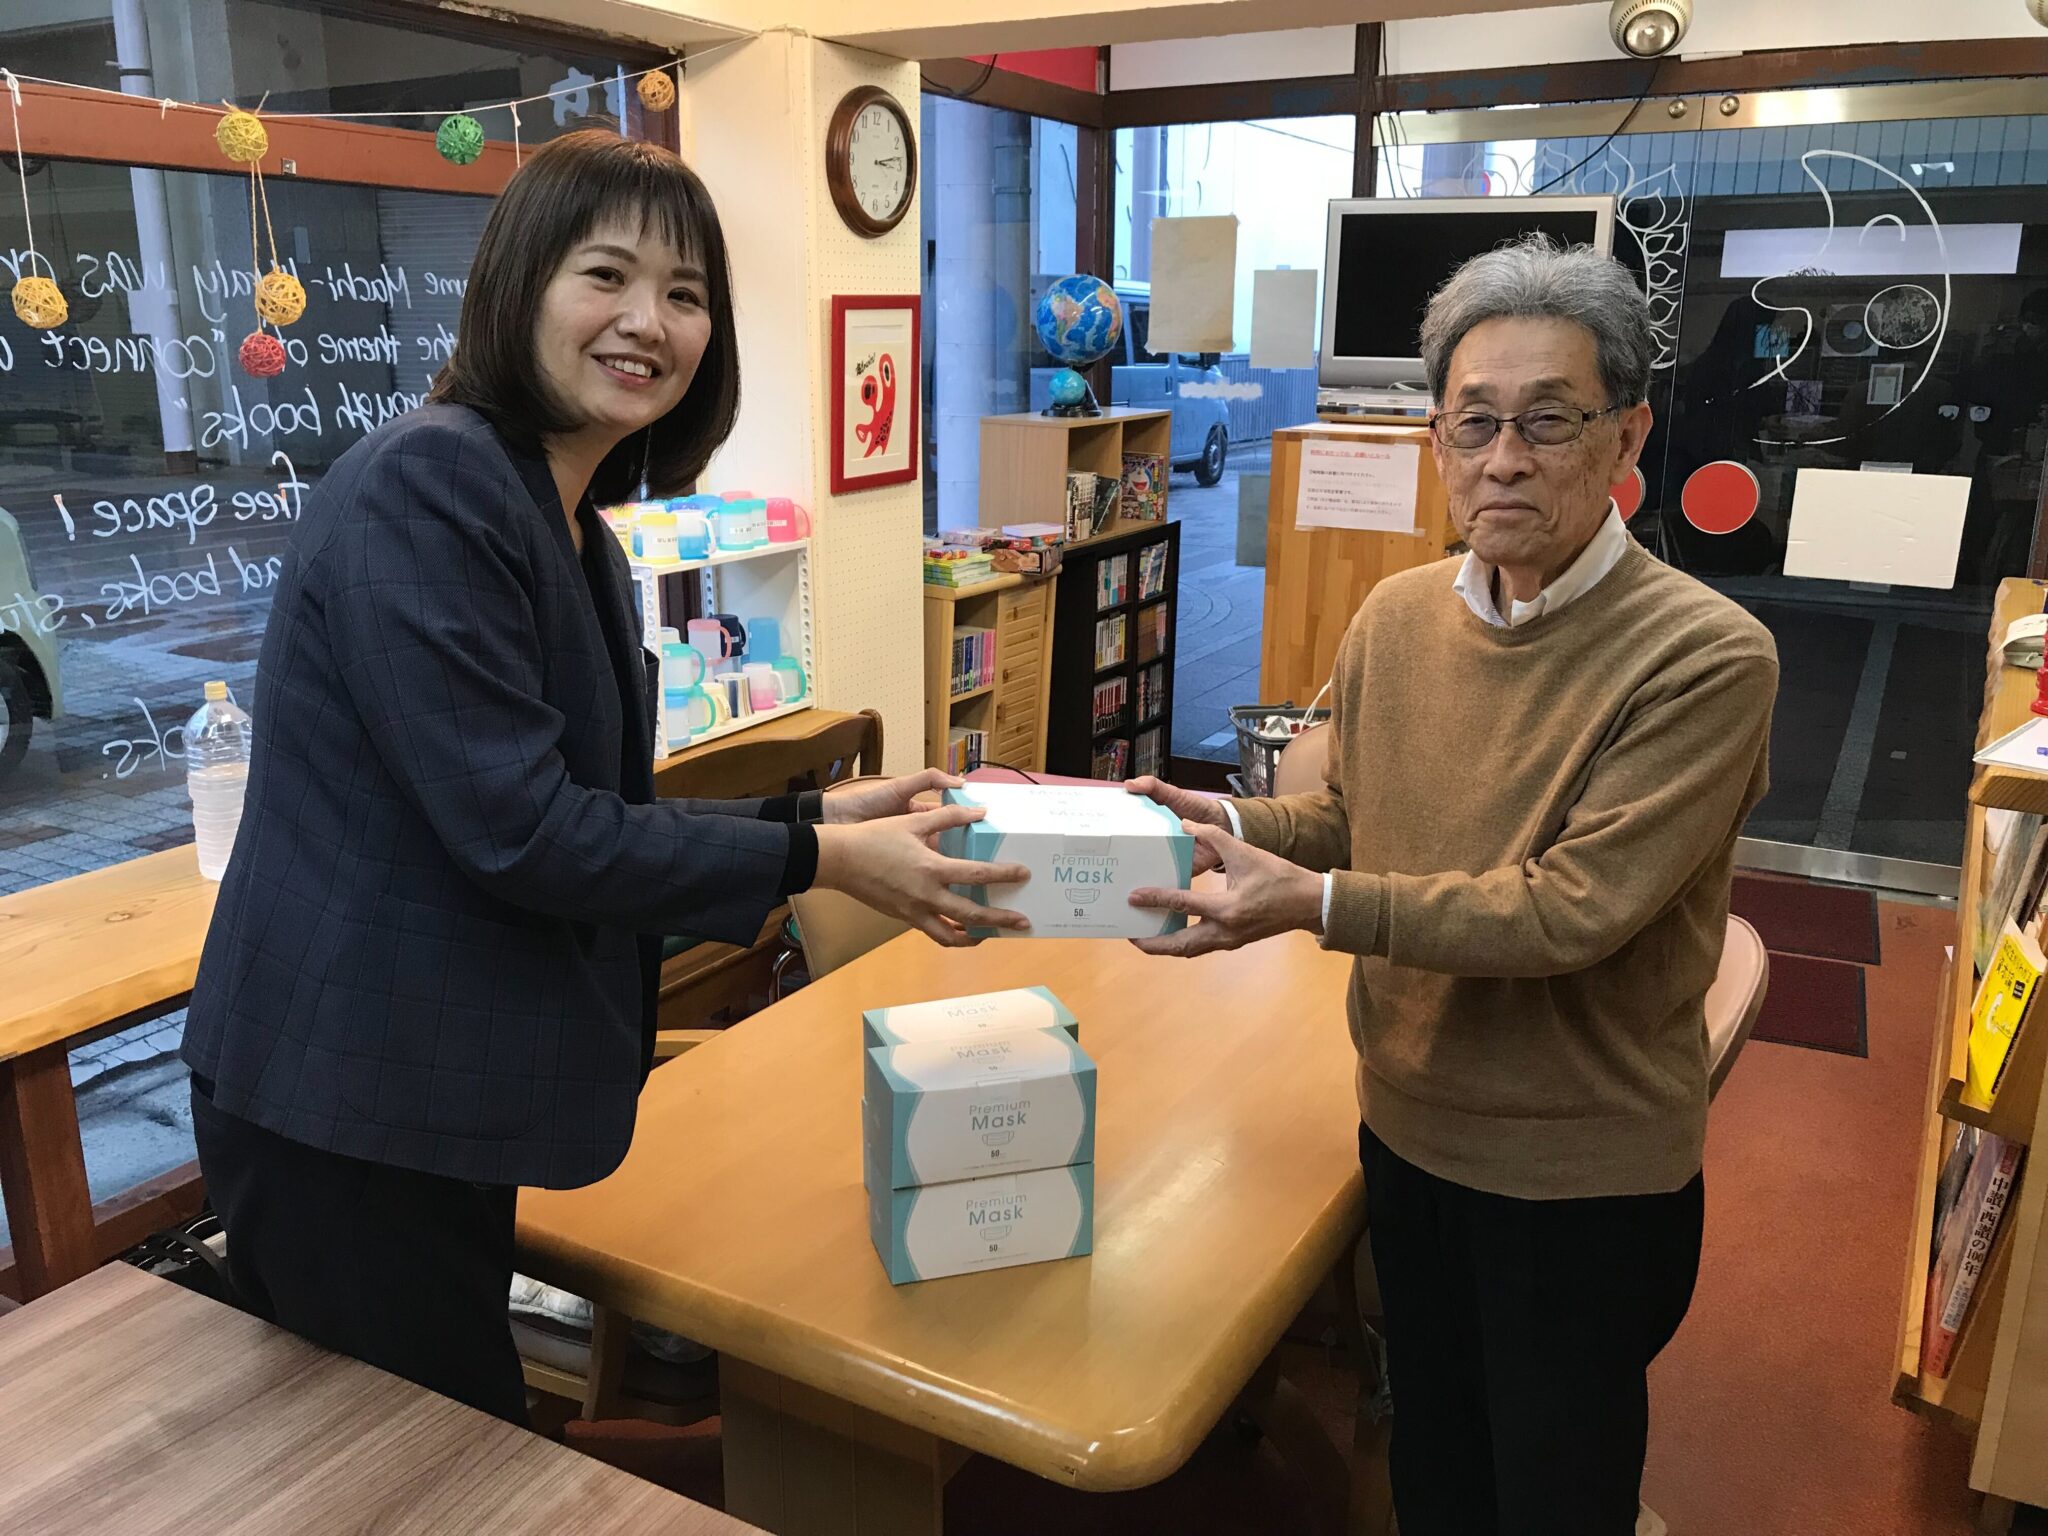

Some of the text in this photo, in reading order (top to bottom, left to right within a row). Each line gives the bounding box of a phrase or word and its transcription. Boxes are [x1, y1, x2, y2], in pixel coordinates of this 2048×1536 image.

[861, 115, 868, 129] 11
[873, 112, 881, 126] 12
[887, 119, 890, 133] 1
[894, 136, 900, 150] 2
[896, 160, 902, 172] 3
[893, 181, 898, 194] 4
[861, 192, 866, 206] 7
[872, 198, 879, 212] 6
[884, 195, 890, 209] 5
[1052, 853, 1119, 867] Premium
[1054, 866, 1114, 884] Mask
[956, 1045, 1012, 1060] Mask
[969, 1099, 1031, 1116] Premium
[972, 1110, 1027, 1131] Mask
[966, 1194, 1027, 1211] Premium
[969, 1204, 1024, 1226] Mask
